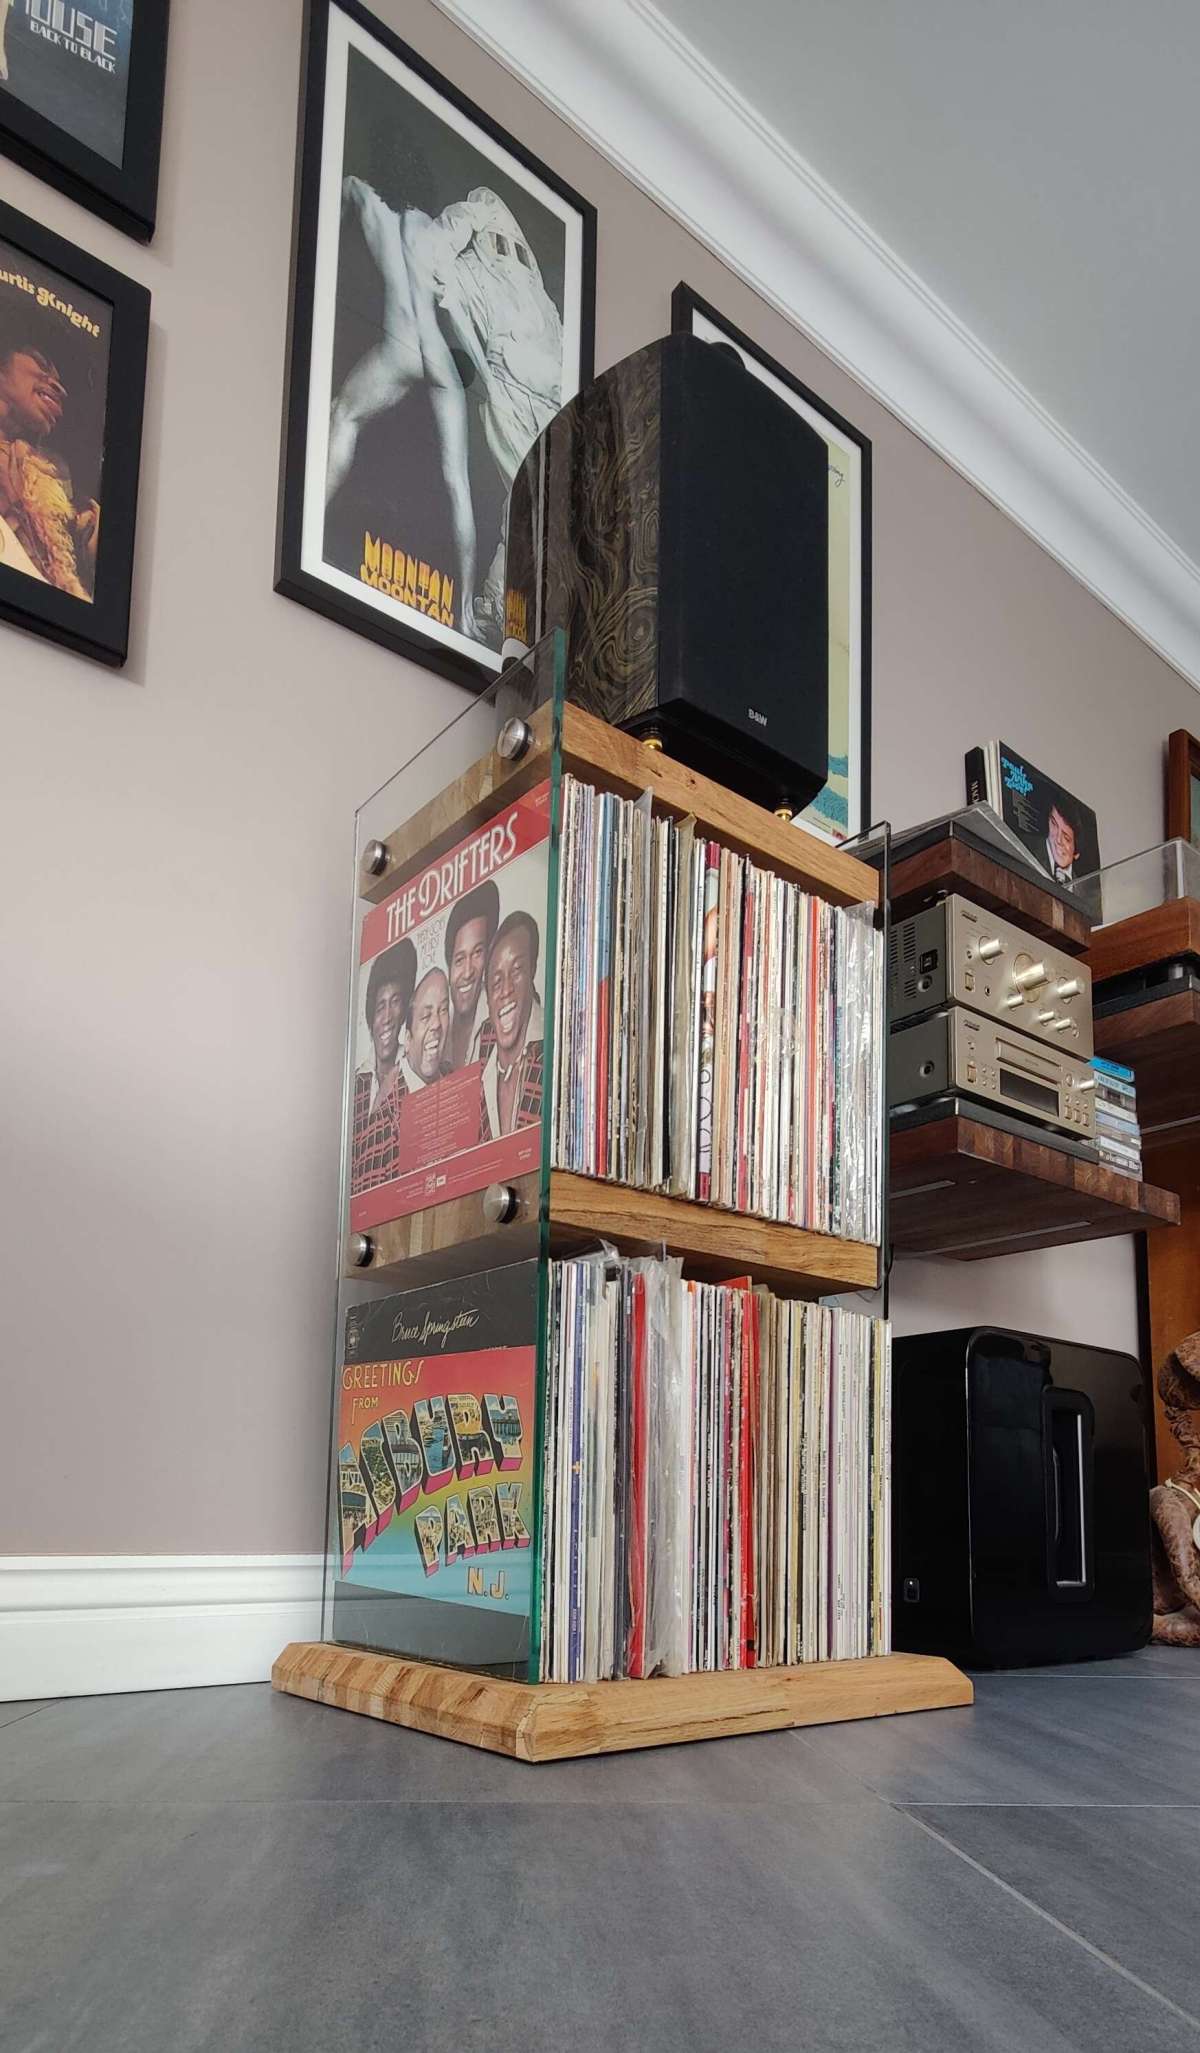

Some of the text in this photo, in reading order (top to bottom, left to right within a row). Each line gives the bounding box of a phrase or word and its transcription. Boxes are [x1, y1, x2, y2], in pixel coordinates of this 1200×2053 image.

[25, 0, 118, 60] OUSE
[30, 20, 116, 74] BACK TO BLACK
[0, 269, 100, 338] urtis Knight
[748, 708, 768, 727] B&W
[386, 886, 416, 943] THE
[418, 812, 518, 918] DRIFTERS
[391, 1311, 420, 1344] Bruce
[342, 1360, 424, 1390] GREETINGS
[351, 1397, 379, 1425] FROM
[338, 1394, 524, 1578] ASBURY
[414, 1482, 531, 1578] PARK
